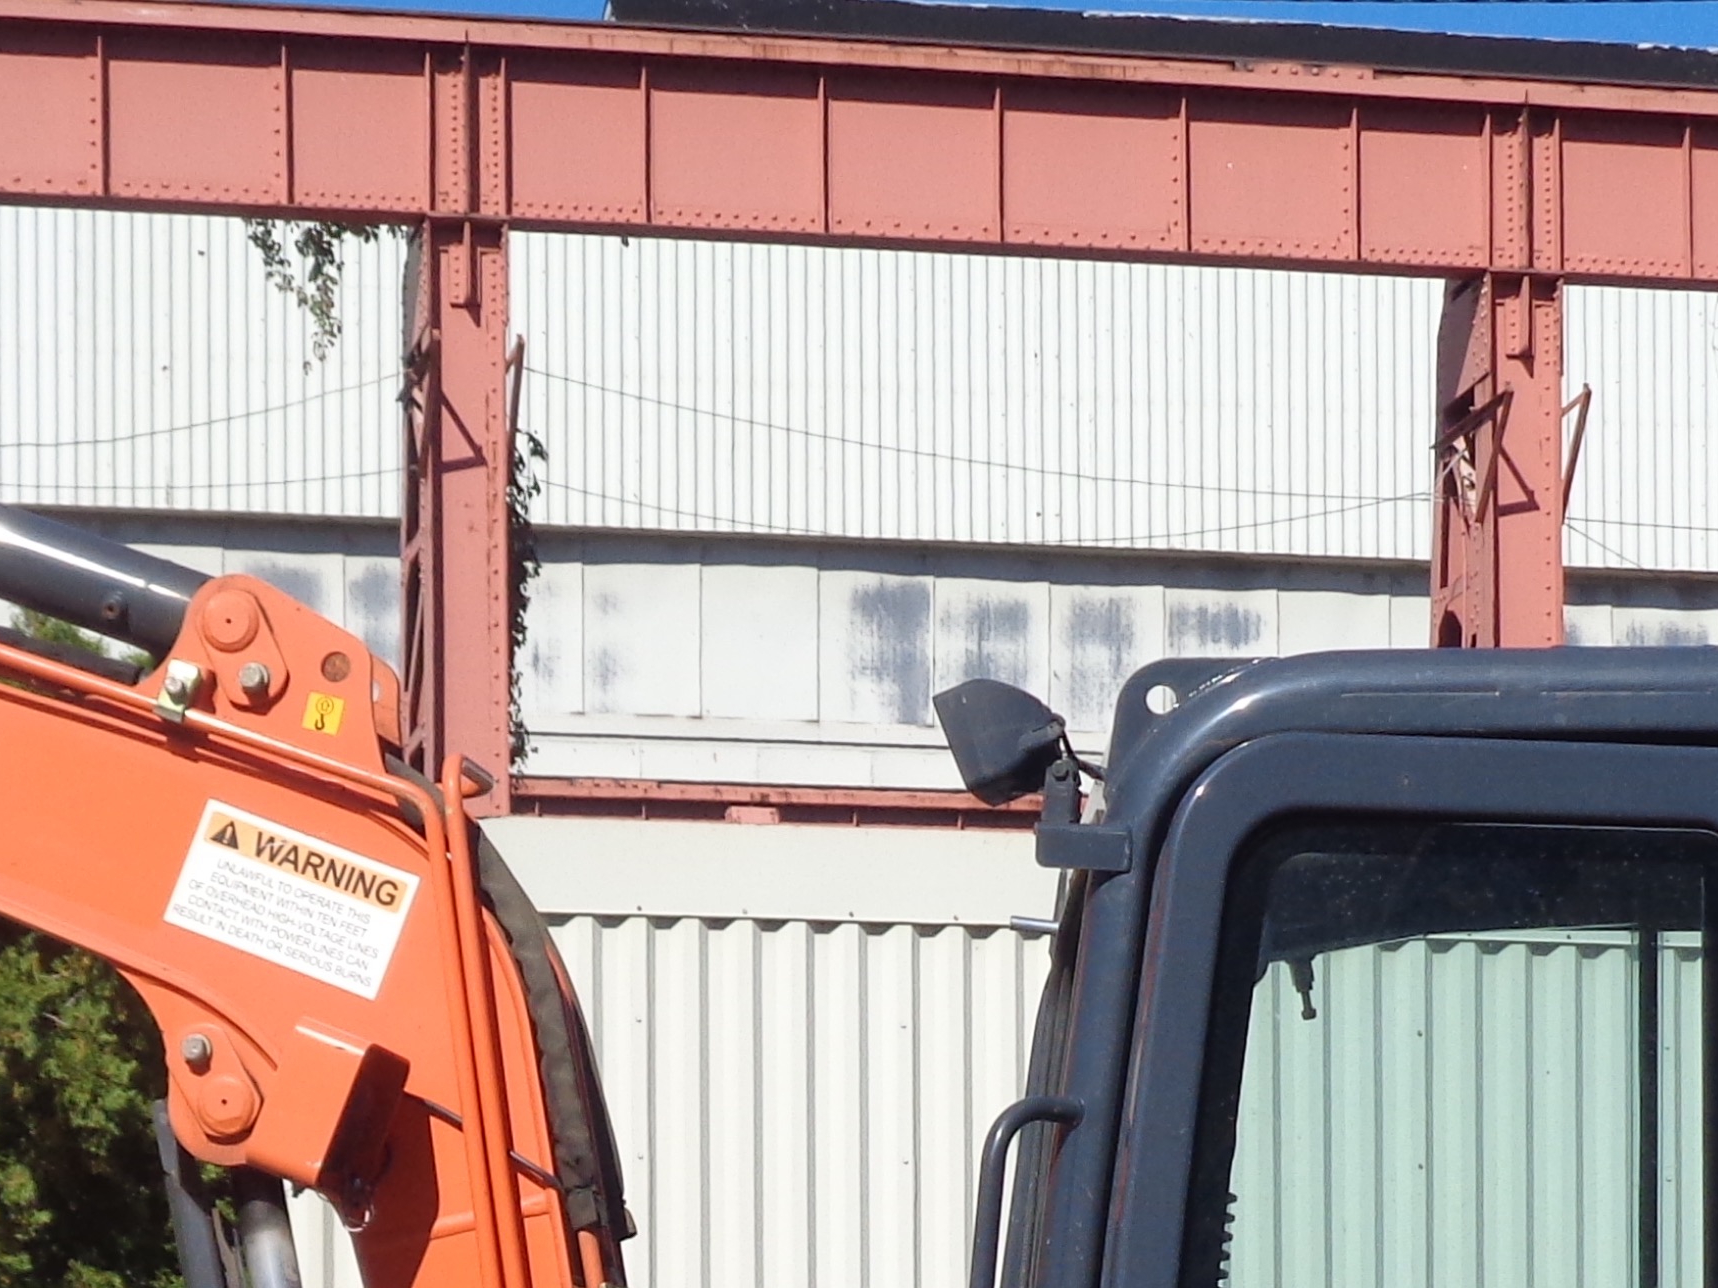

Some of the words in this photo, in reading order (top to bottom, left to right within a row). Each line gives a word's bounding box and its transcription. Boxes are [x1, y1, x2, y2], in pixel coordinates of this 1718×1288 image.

[210, 871, 274, 902] EQUIPMENT
[276, 897, 315, 919] WITHIN
[317, 911, 338, 927] TEN
[340, 920, 367, 938] FEET
[217, 858, 274, 889] UNLAWFUL
[278, 881, 292, 894] TO
[294, 888, 345, 914] OPERATE
[347, 907, 371, 924] THIS
[254, 831, 400, 907] WARNING
[172, 903, 214, 926] RESULT
[215, 919, 228, 932] IN
[227, 924, 264, 944] DEATH
[266, 938, 283, 953] OR
[284, 946, 333, 972] SERIOUS
[334, 965, 373, 987] BURNS
[188, 879, 205, 891] OF
[205, 885, 266, 915] OVERHEAD
[268, 910, 347, 946] HIGH-VOLTAGE
[348, 940, 379, 959] LINES
[188, 894, 240, 921] CONTACT
[241, 915, 268, 932] WITH
[271, 924, 311, 948] POWER
[312, 941, 345, 961] LINES
[346, 954, 370, 971] CAN
